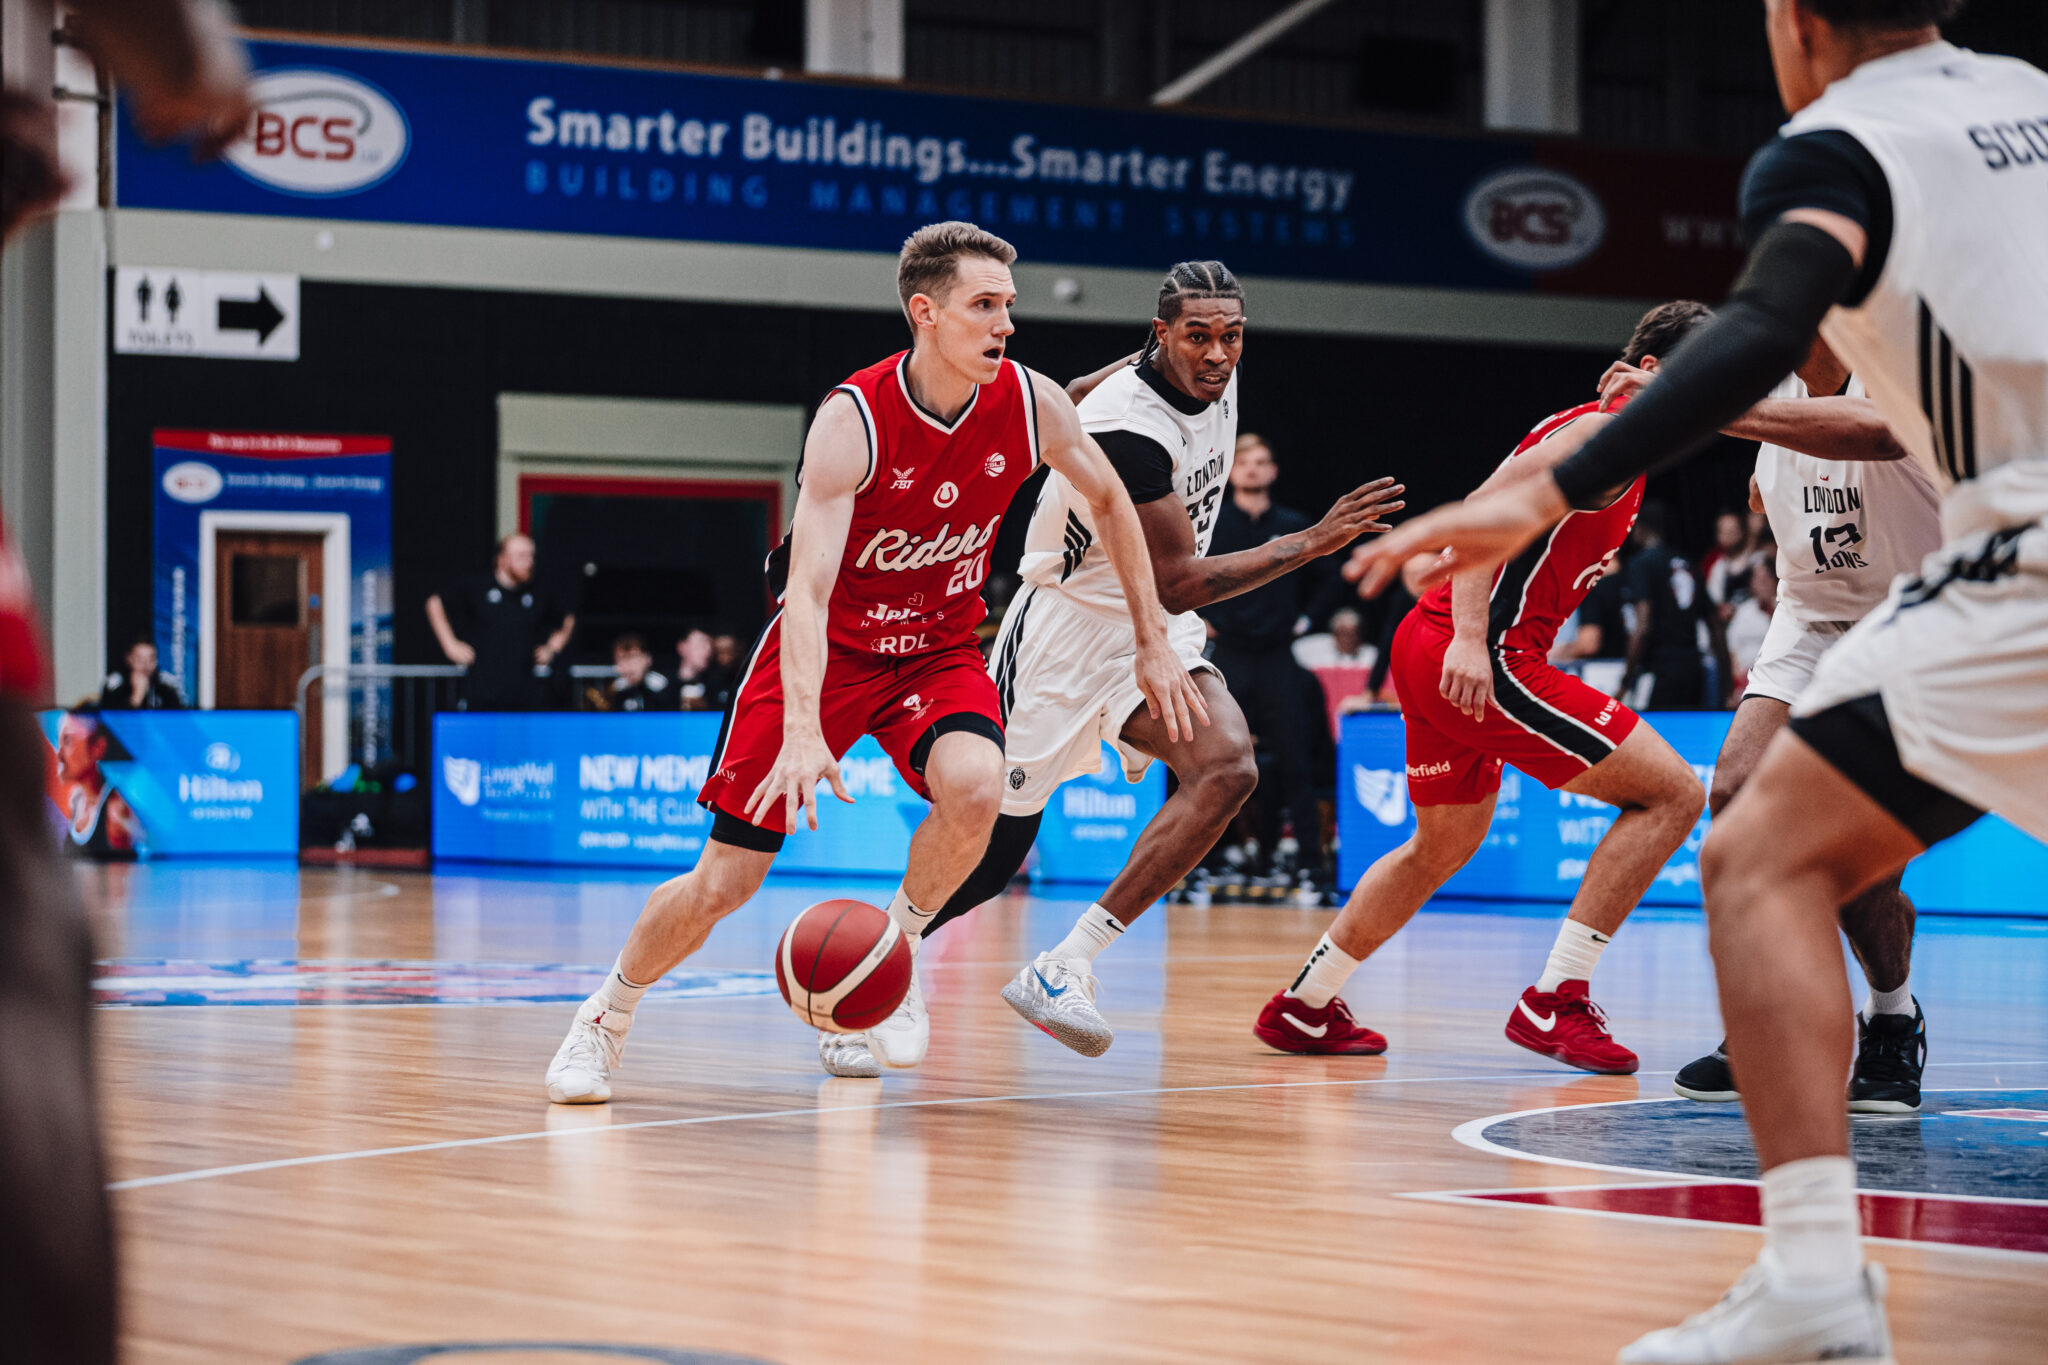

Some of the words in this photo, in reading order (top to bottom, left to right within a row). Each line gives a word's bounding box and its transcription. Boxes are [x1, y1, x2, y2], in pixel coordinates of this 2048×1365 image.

[256, 113, 355, 161] BCS
[527, 97, 730, 156] Smarter
[1203, 150, 1354, 213] Energy
[1966, 117, 2048, 171] SCO
[524, 160, 768, 208] BUILDING
[810, 179, 1123, 231] MANAGEMENT
[1165, 206, 1355, 248] SYSTEMS
[1489, 202, 1571, 245] BCS
[890, 480, 914, 490] FBT
[1187, 451, 1225, 497] LONDON
[1804, 486, 1861, 514] LONDON
[855, 514, 1001, 572] Riders
[945, 549, 987, 597] 20
[880, 633, 930, 654] RDL
[178, 773, 263, 803] Hilton
[579, 754, 640, 792] NEW
[641, 754, 712, 793] MEM
